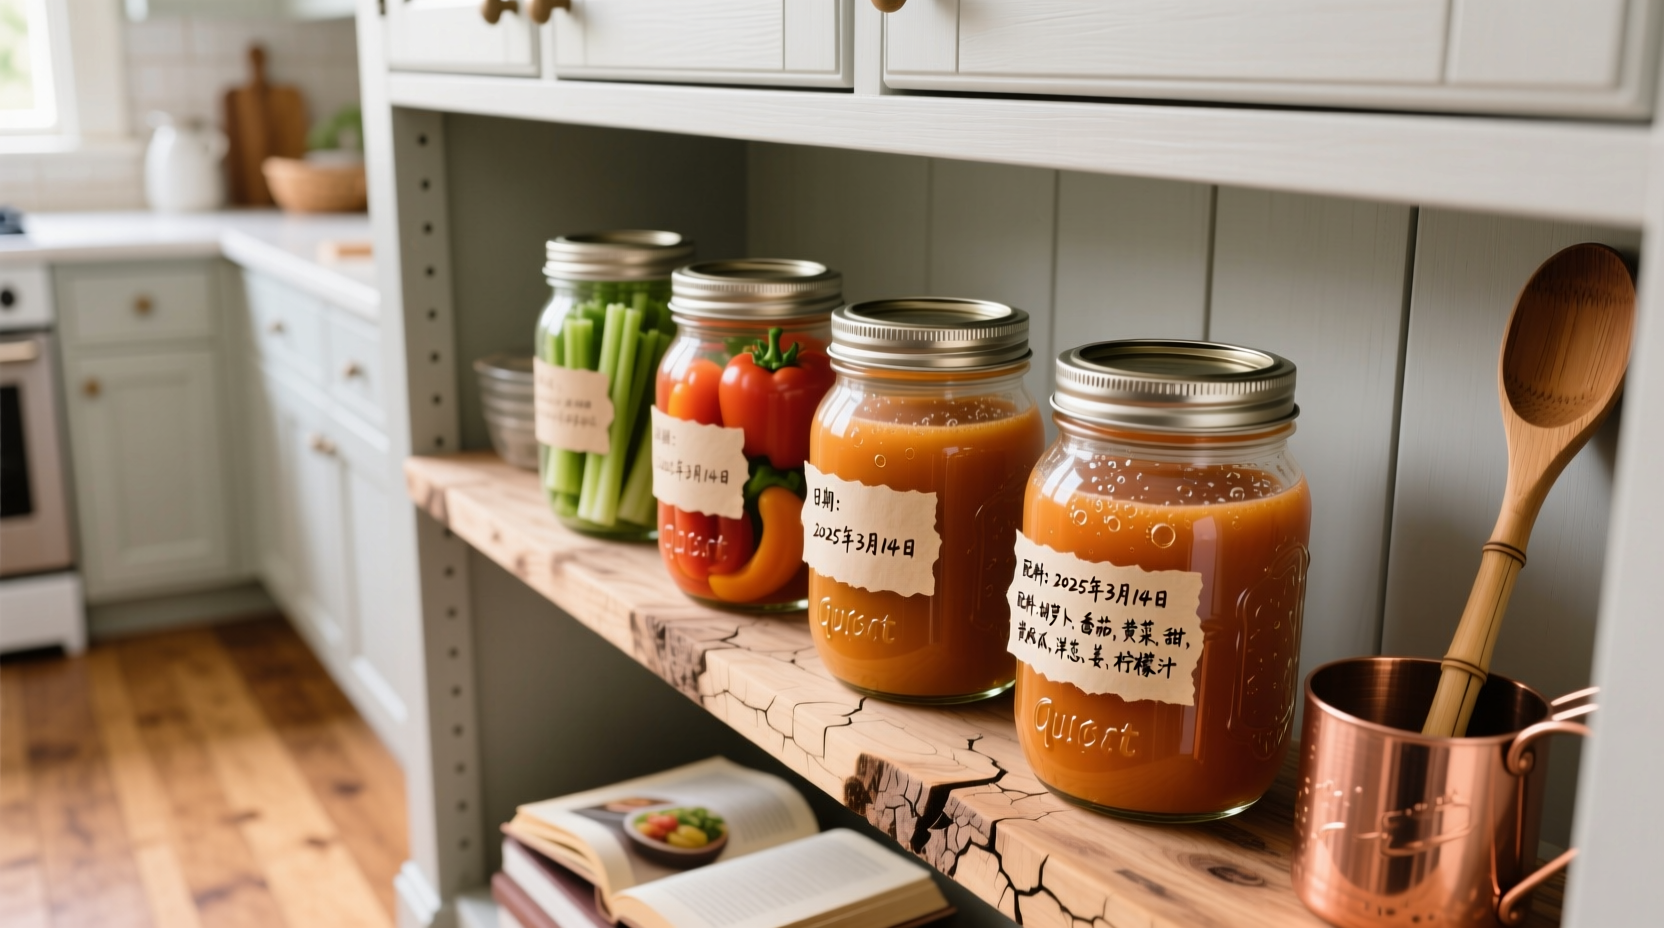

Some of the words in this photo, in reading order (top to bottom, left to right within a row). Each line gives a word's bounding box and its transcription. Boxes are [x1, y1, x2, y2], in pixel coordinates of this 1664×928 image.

[813, 487, 840, 512] 日期:
[812, 522, 916, 559] 2025年3月14日
